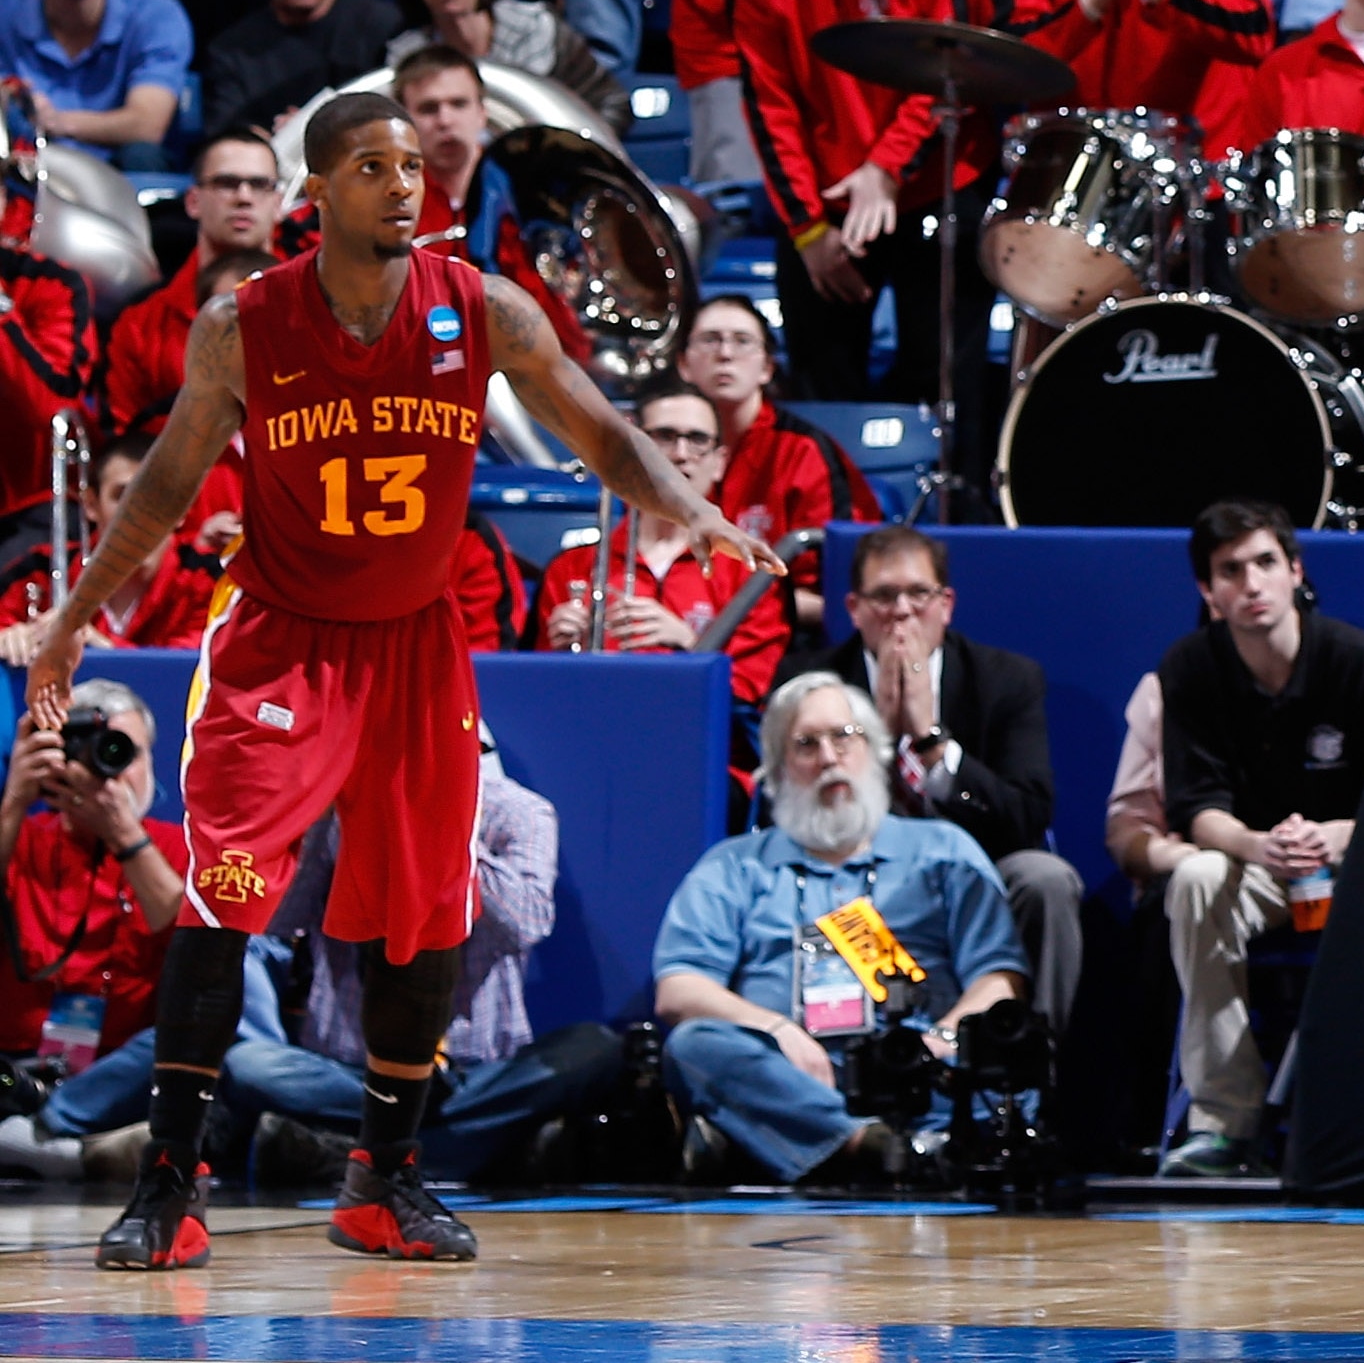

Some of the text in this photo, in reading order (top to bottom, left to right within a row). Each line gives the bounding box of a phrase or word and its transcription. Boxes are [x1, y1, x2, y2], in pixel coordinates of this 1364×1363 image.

[1103, 329, 1219, 382] Pearl
[266, 396, 477, 451] IOWA STATE
[319, 454, 427, 536] 13
[198, 864, 267, 899] STATE
